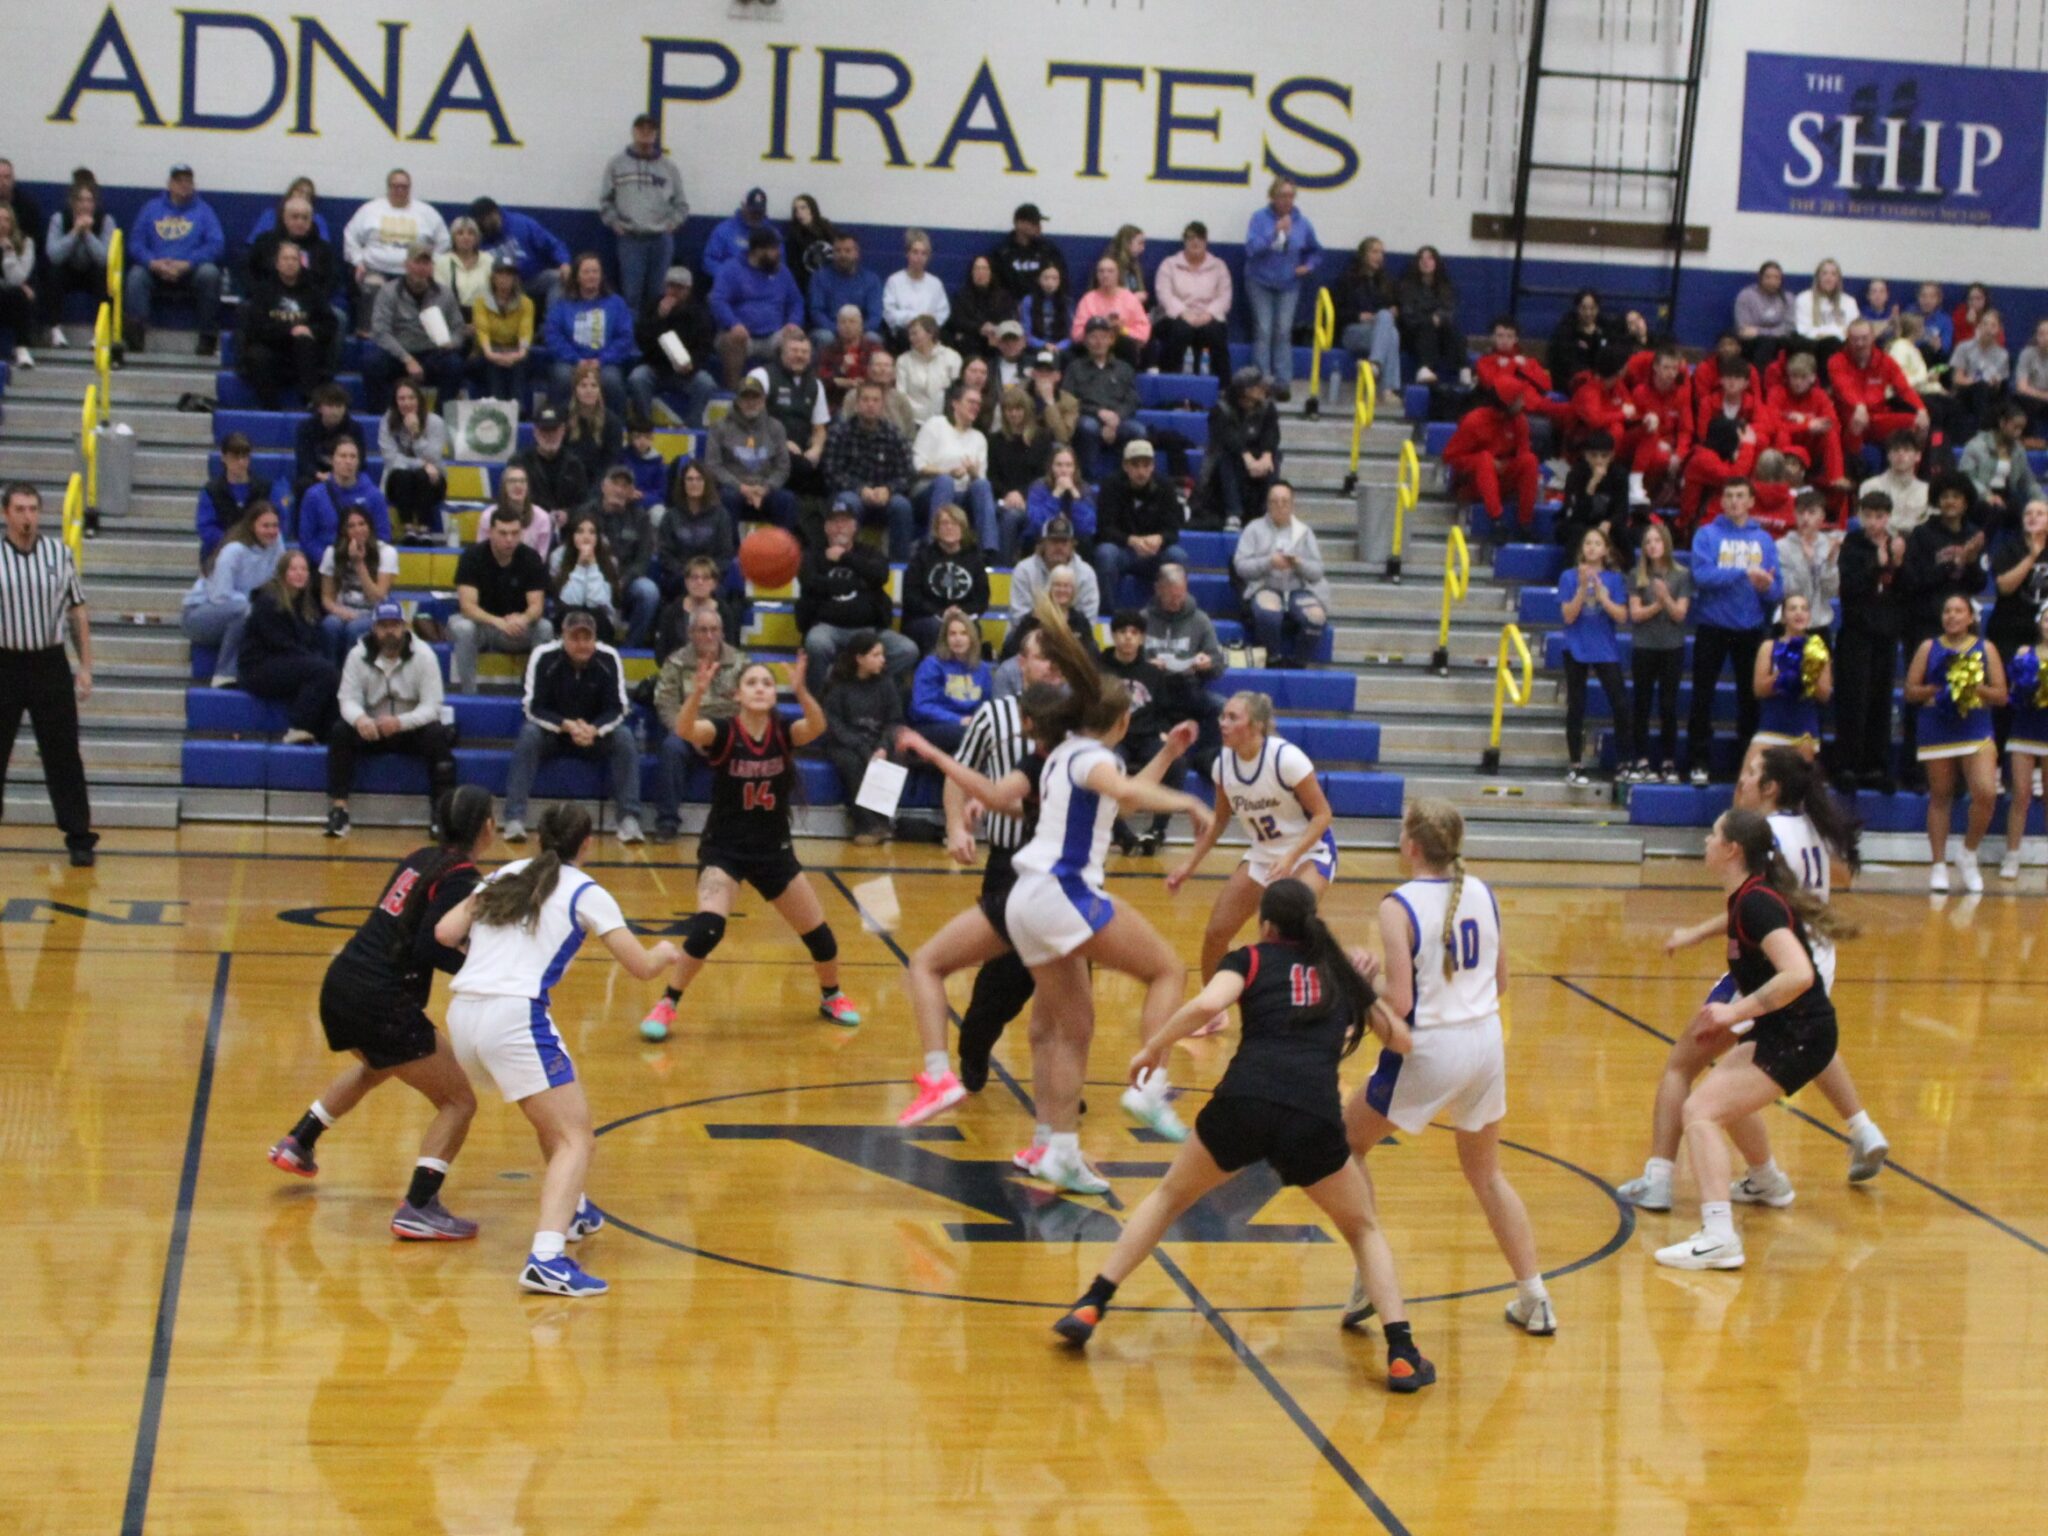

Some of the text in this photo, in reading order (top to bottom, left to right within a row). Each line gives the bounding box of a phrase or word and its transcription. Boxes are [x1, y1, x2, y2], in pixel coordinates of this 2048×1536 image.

[46, 6, 1361, 190] ADNA PIRATES
[1804, 72, 1846, 94] THE
[1782, 110, 2004, 198] SHIP
[743, 780, 776, 811] 14
[1232, 795, 1281, 812] Pirates
[1248, 814, 1283, 842] 12
[1288, 962, 1322, 1007] 11
